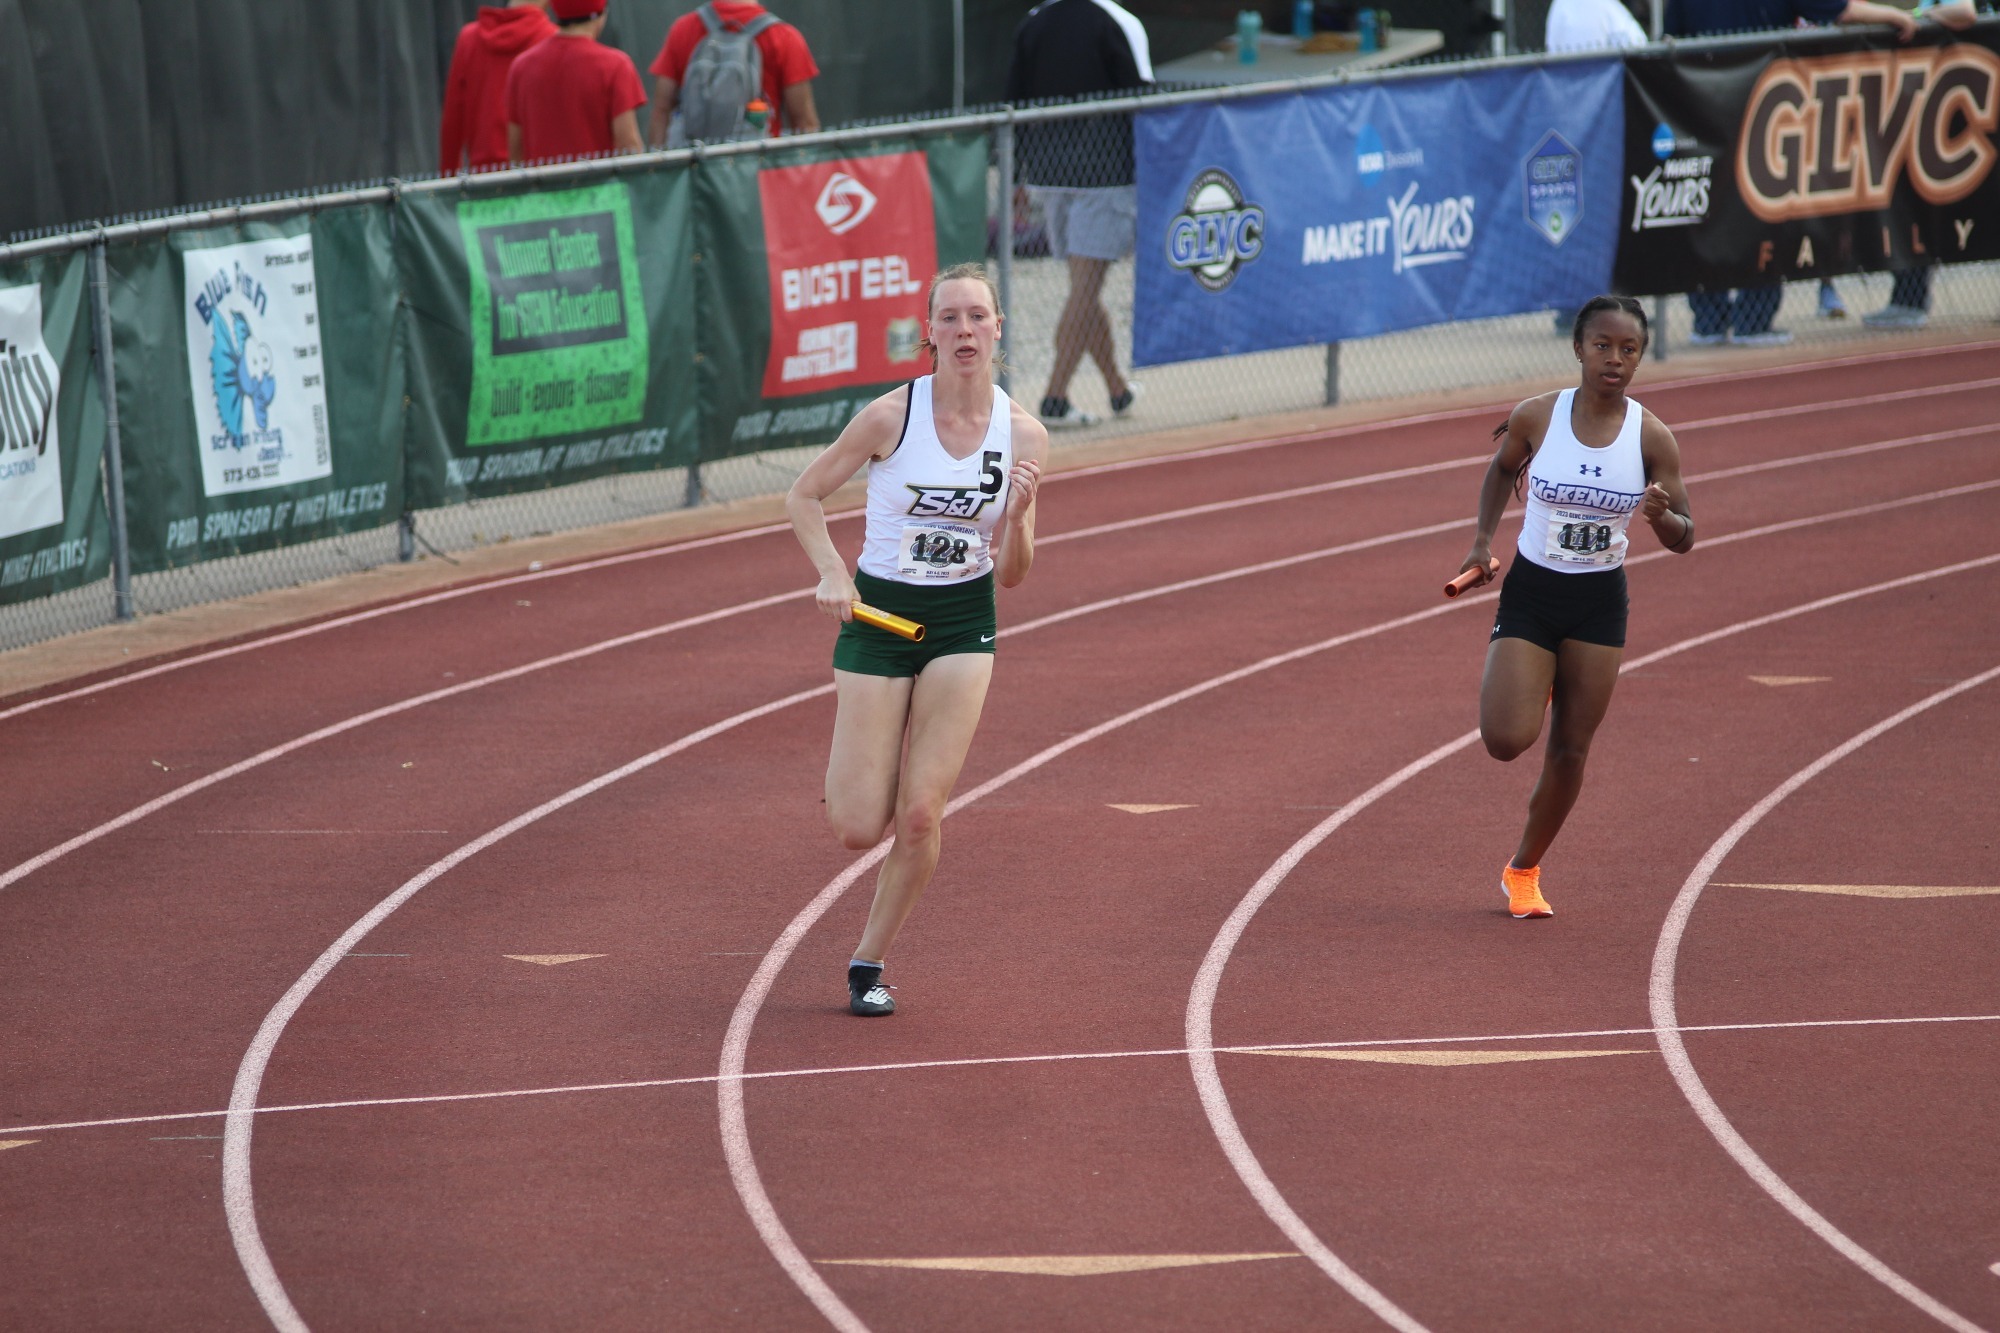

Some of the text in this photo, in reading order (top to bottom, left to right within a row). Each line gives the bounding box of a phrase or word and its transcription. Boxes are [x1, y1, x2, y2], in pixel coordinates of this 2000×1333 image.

[1738, 46, 2000, 223] GLVC
[1302, 181, 1476, 275] MAKE IT YOURS
[1630, 165, 1711, 232] YOURS
[1165, 205, 1265, 269] GLVC
[1757, 217, 1975, 273] FAILY
[781, 254, 922, 313] BIOSTEEL
[979, 450, 1003, 495] 5
[203, 504, 271, 543] SPONSOR
[912, 532, 970, 565] 128
